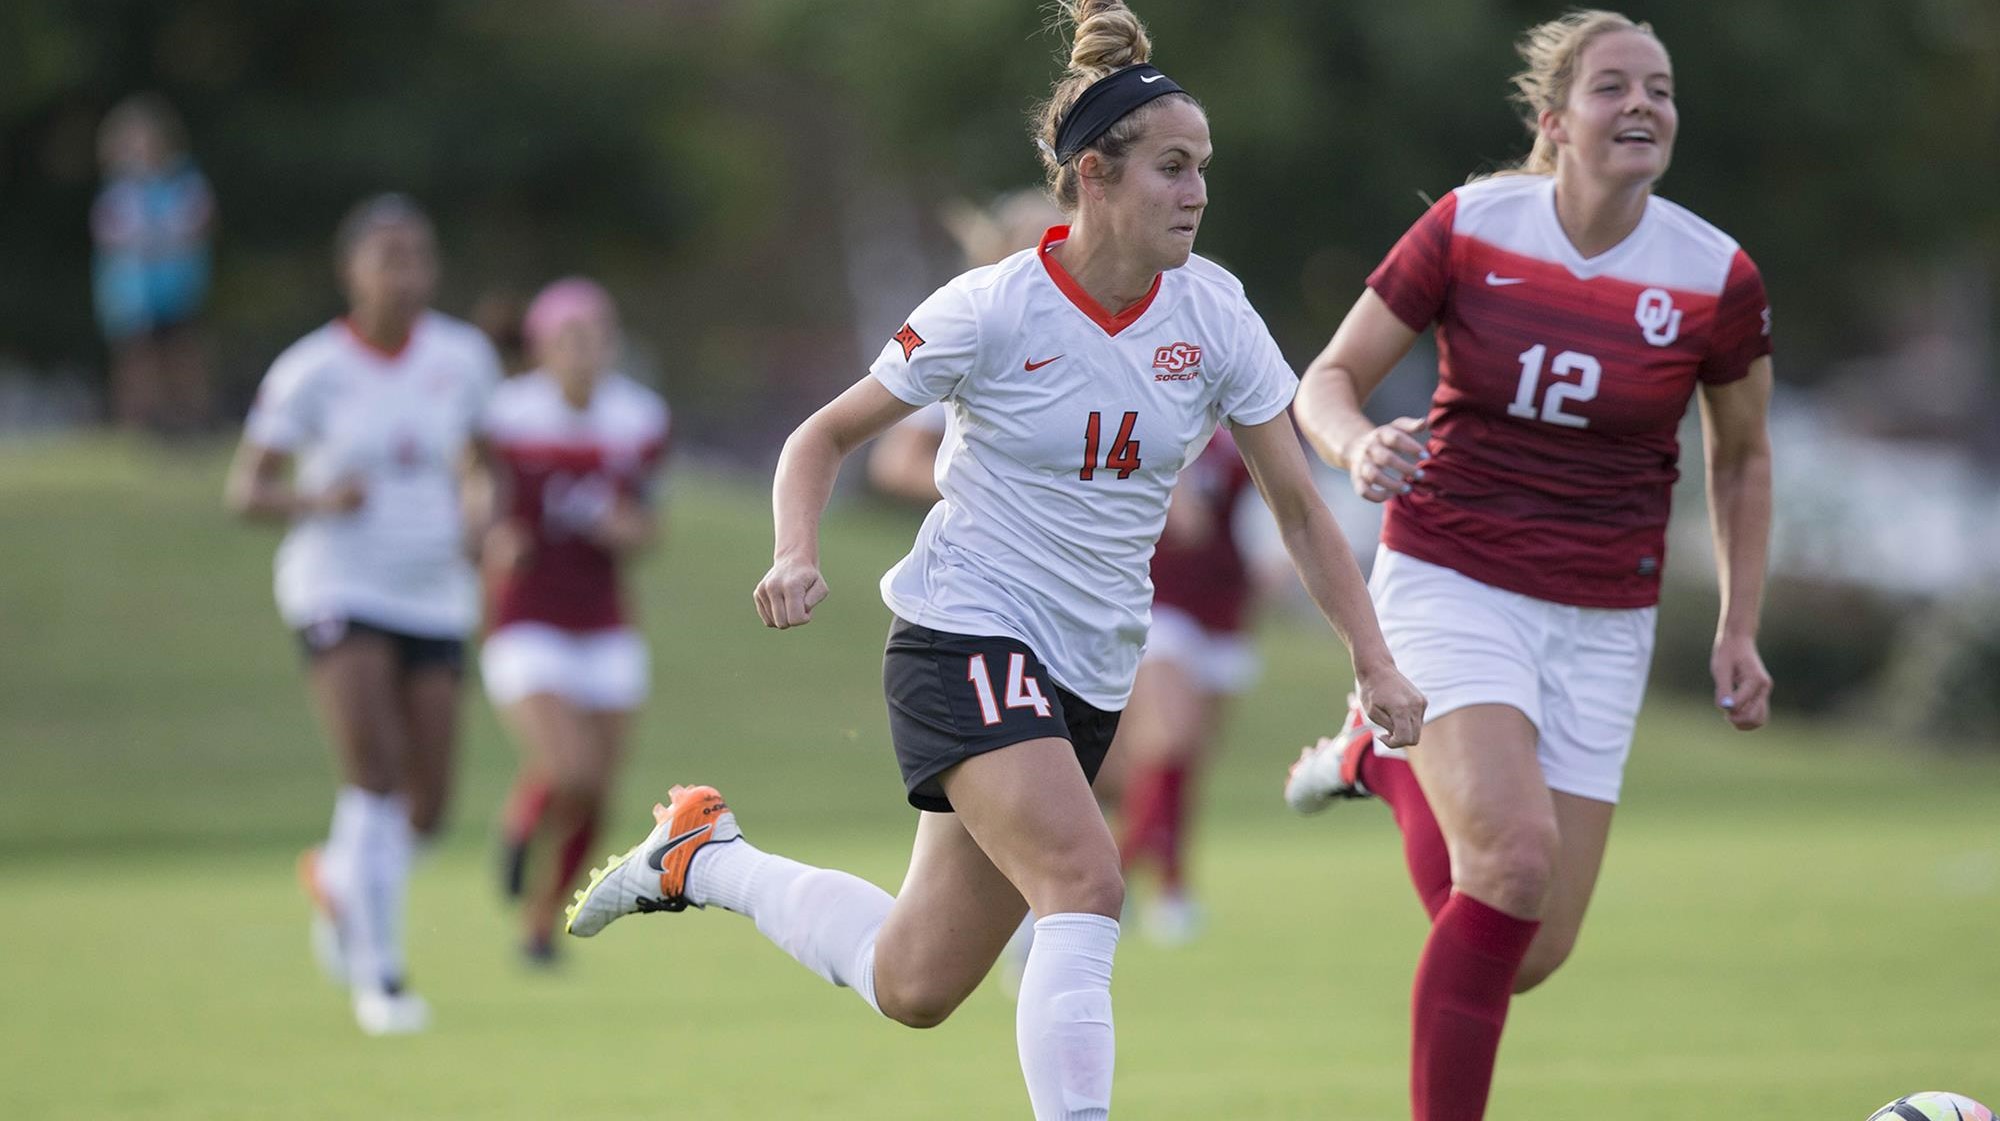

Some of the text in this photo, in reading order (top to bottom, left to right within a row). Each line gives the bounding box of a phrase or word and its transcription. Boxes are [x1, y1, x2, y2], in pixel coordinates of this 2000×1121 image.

[1634, 288, 1683, 346] OU
[1155, 344, 1201, 370] OSU
[1507, 344, 1602, 428] 12
[1079, 411, 1141, 481] 14
[967, 652, 1052, 727] 14
